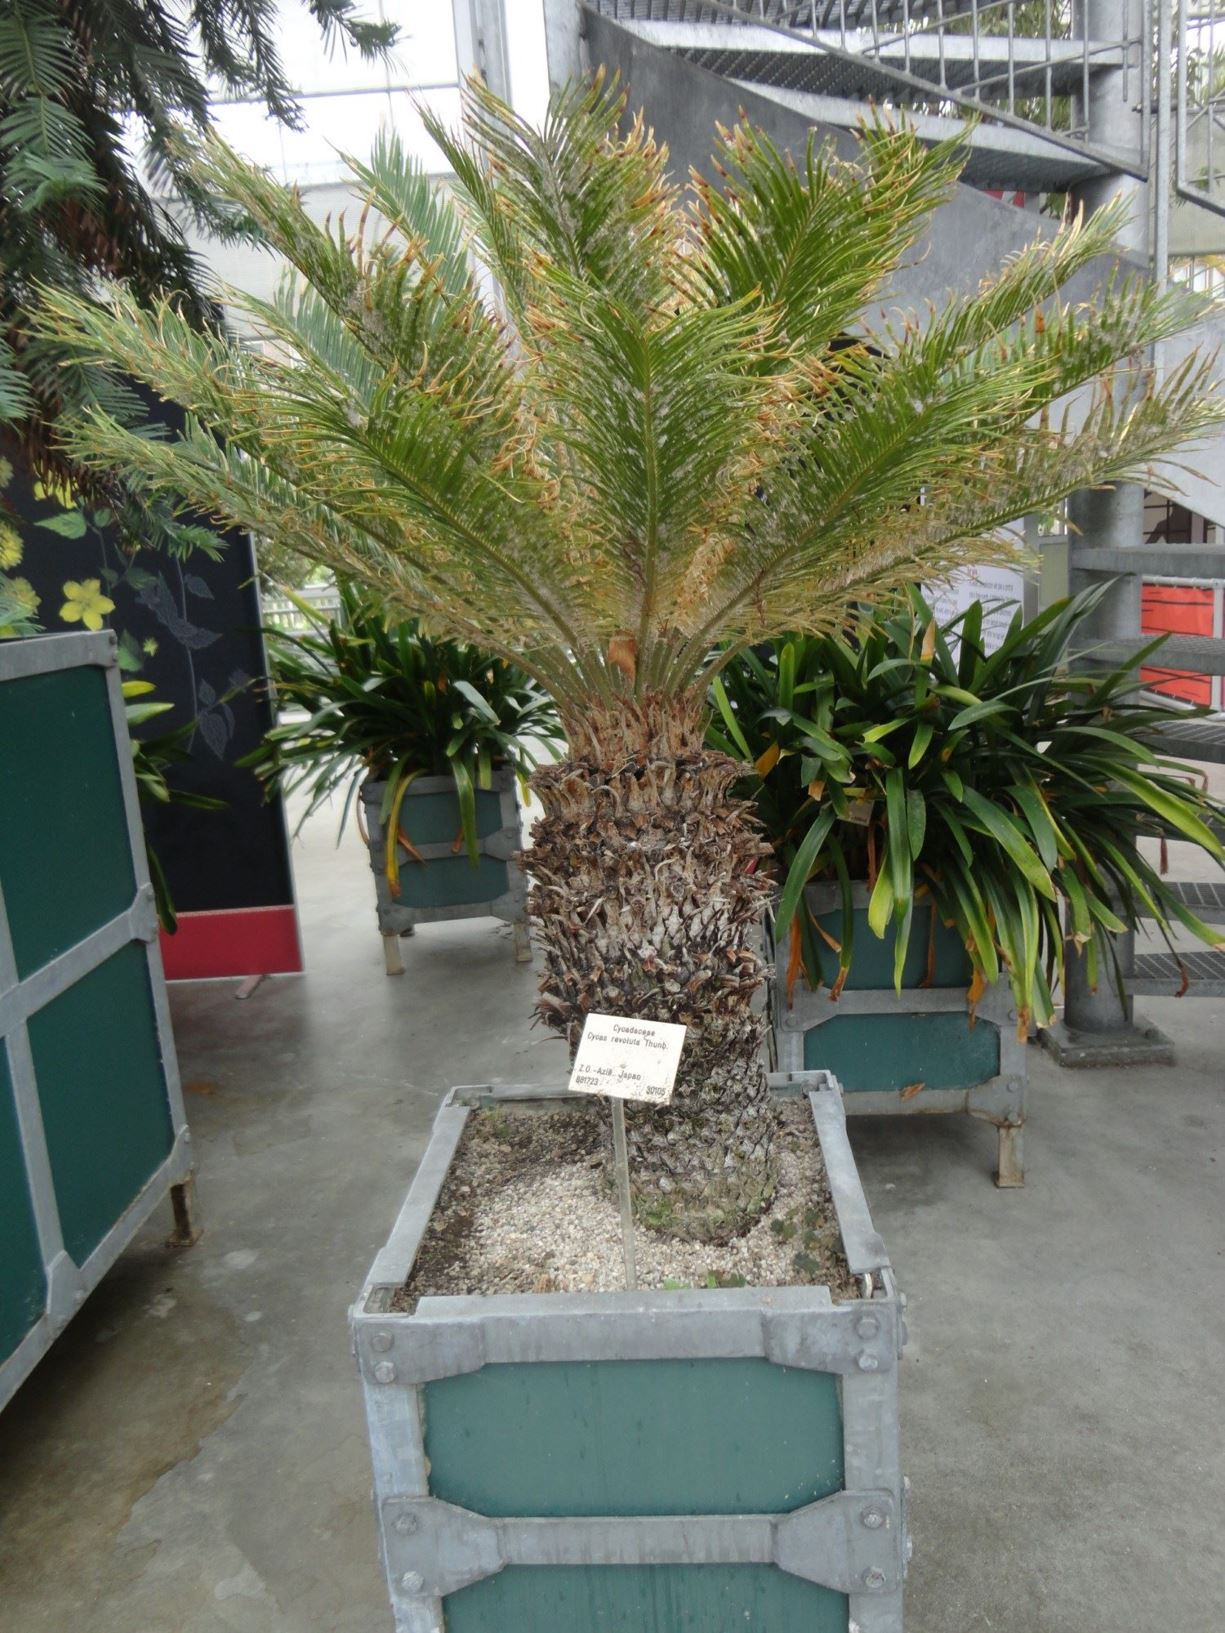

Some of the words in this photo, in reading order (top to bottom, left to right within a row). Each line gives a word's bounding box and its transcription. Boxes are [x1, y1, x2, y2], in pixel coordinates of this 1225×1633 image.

[587, 1031, 608, 1042] Cycas
[611, 1036, 641, 1046] revoluta
[644, 1039, 668, 1050] Thunb.
[618, 1070, 641, 1080] Japan
